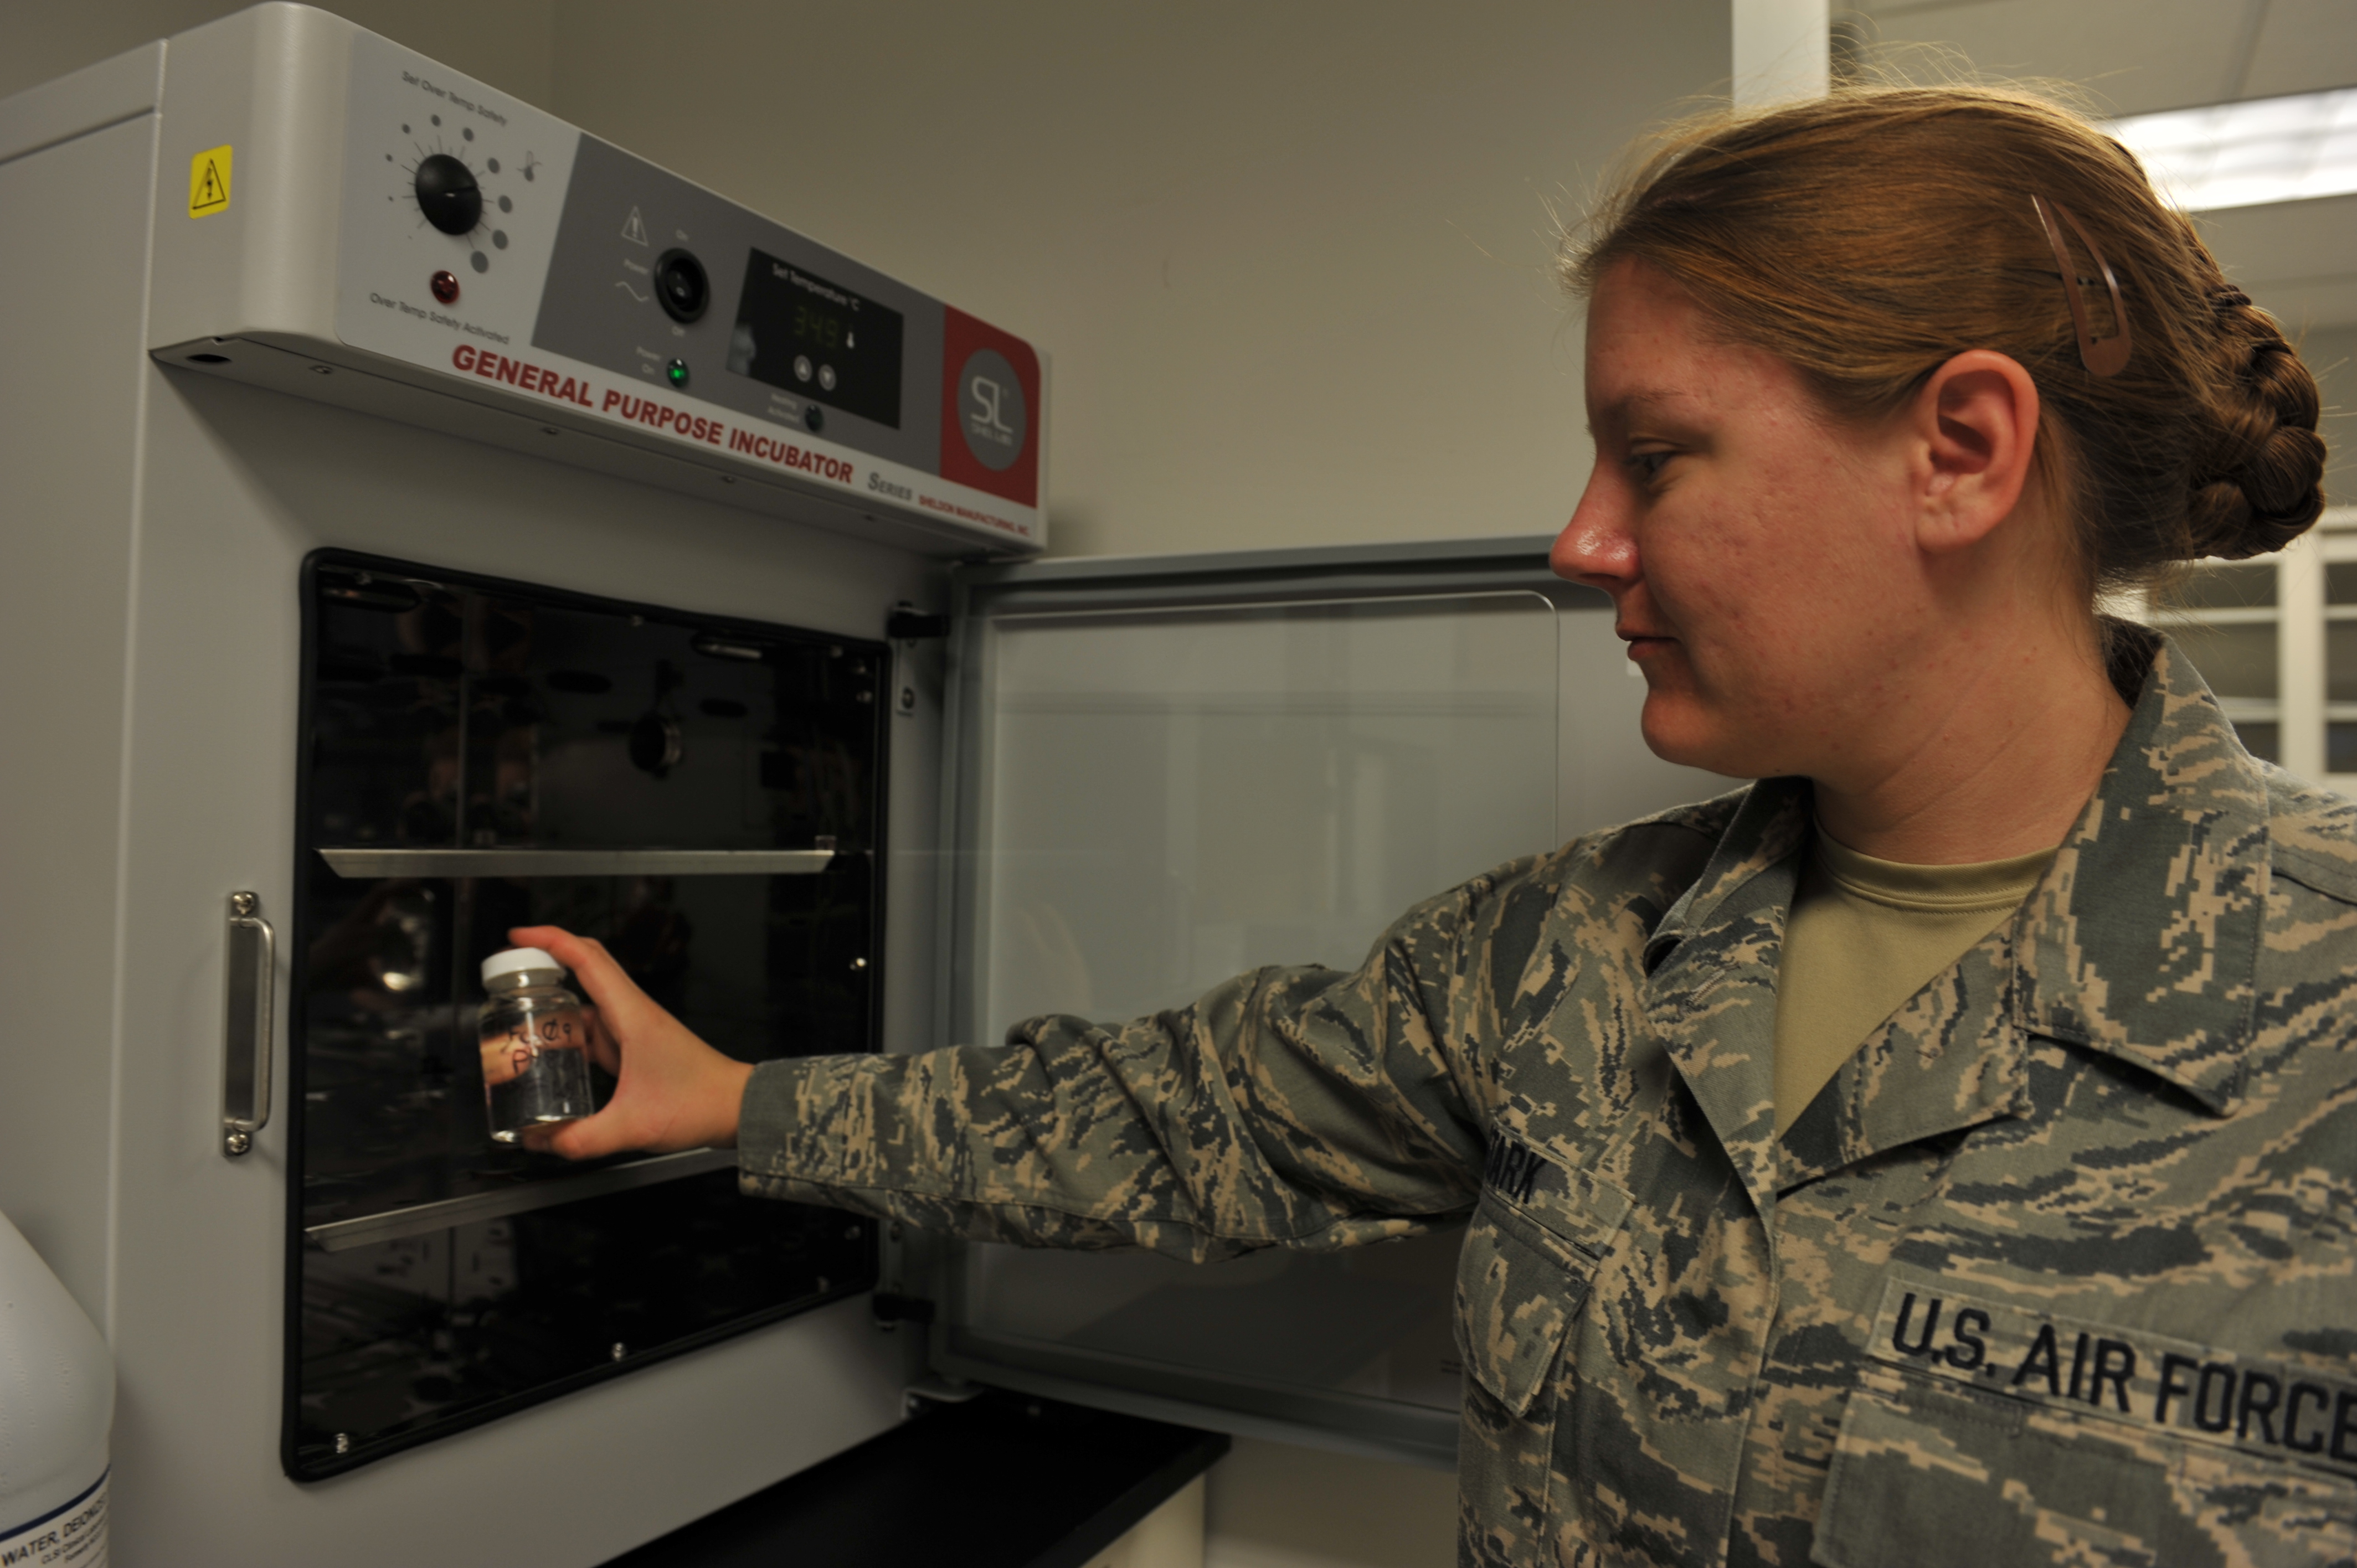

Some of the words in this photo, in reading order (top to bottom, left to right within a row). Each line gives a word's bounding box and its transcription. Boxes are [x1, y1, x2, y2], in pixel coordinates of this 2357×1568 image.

[402, 71, 419, 86] Set
[421, 80, 446, 97] Over
[448, 91, 475, 112] Temp
[477, 105, 507, 127] Safety
[370, 292, 396, 309] Over
[399, 301, 427, 320] Temp
[429, 311, 462, 331] Safety
[462, 322, 510, 345] Activated
[452, 344, 594, 408] GENERAL
[601, 389, 723, 445] PURPOSE
[729, 428, 853, 484] INCUBATOR
[1892, 1292, 1996, 1378] U.S.
[2011, 1323, 2137, 1413] AIR
[2154, 1352, 2357, 1462] FORCE
